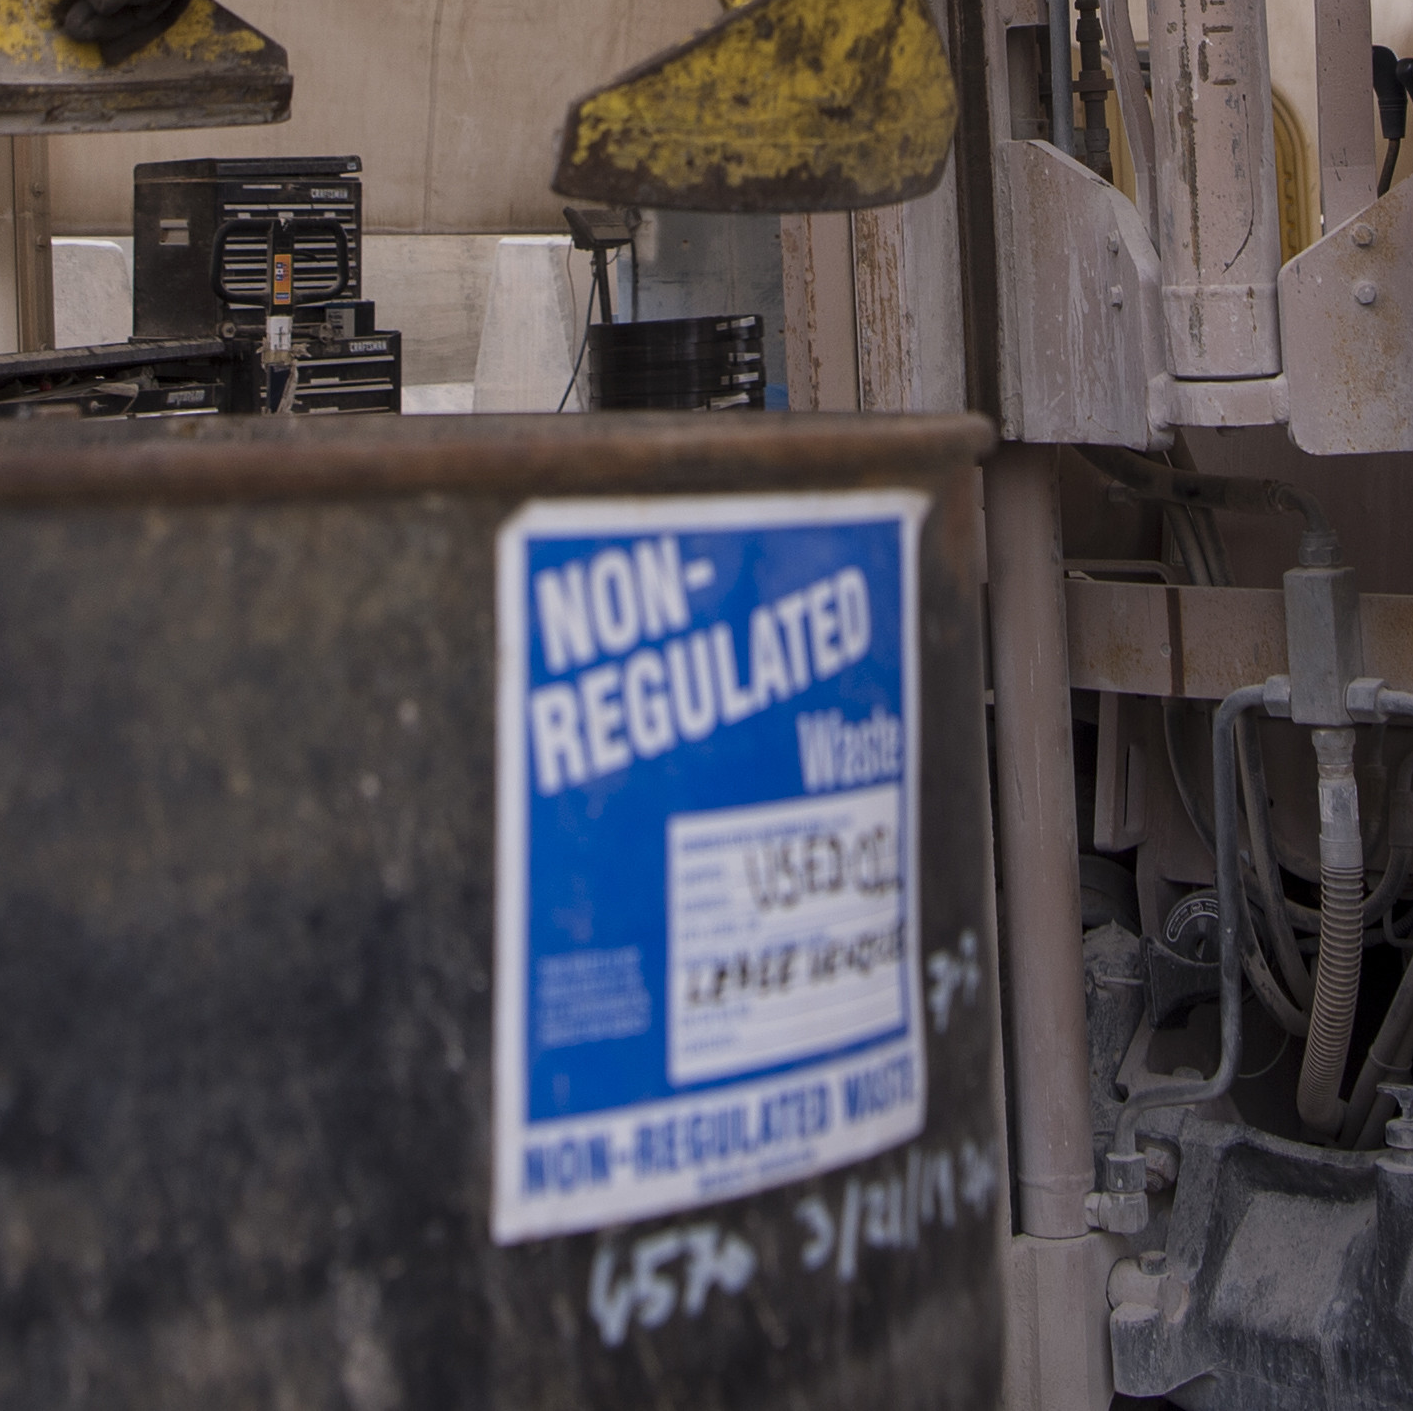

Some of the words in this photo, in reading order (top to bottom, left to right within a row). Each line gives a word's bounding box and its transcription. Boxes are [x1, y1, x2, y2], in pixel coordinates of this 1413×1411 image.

[536, 534, 714, 675] NON-
[531, 565, 872, 797] REGULATED
[795, 703, 903, 794] Waste
[524, 1072, 835, 1196] NON-REGULATED
[839, 1050, 917, 1124] WASTE
